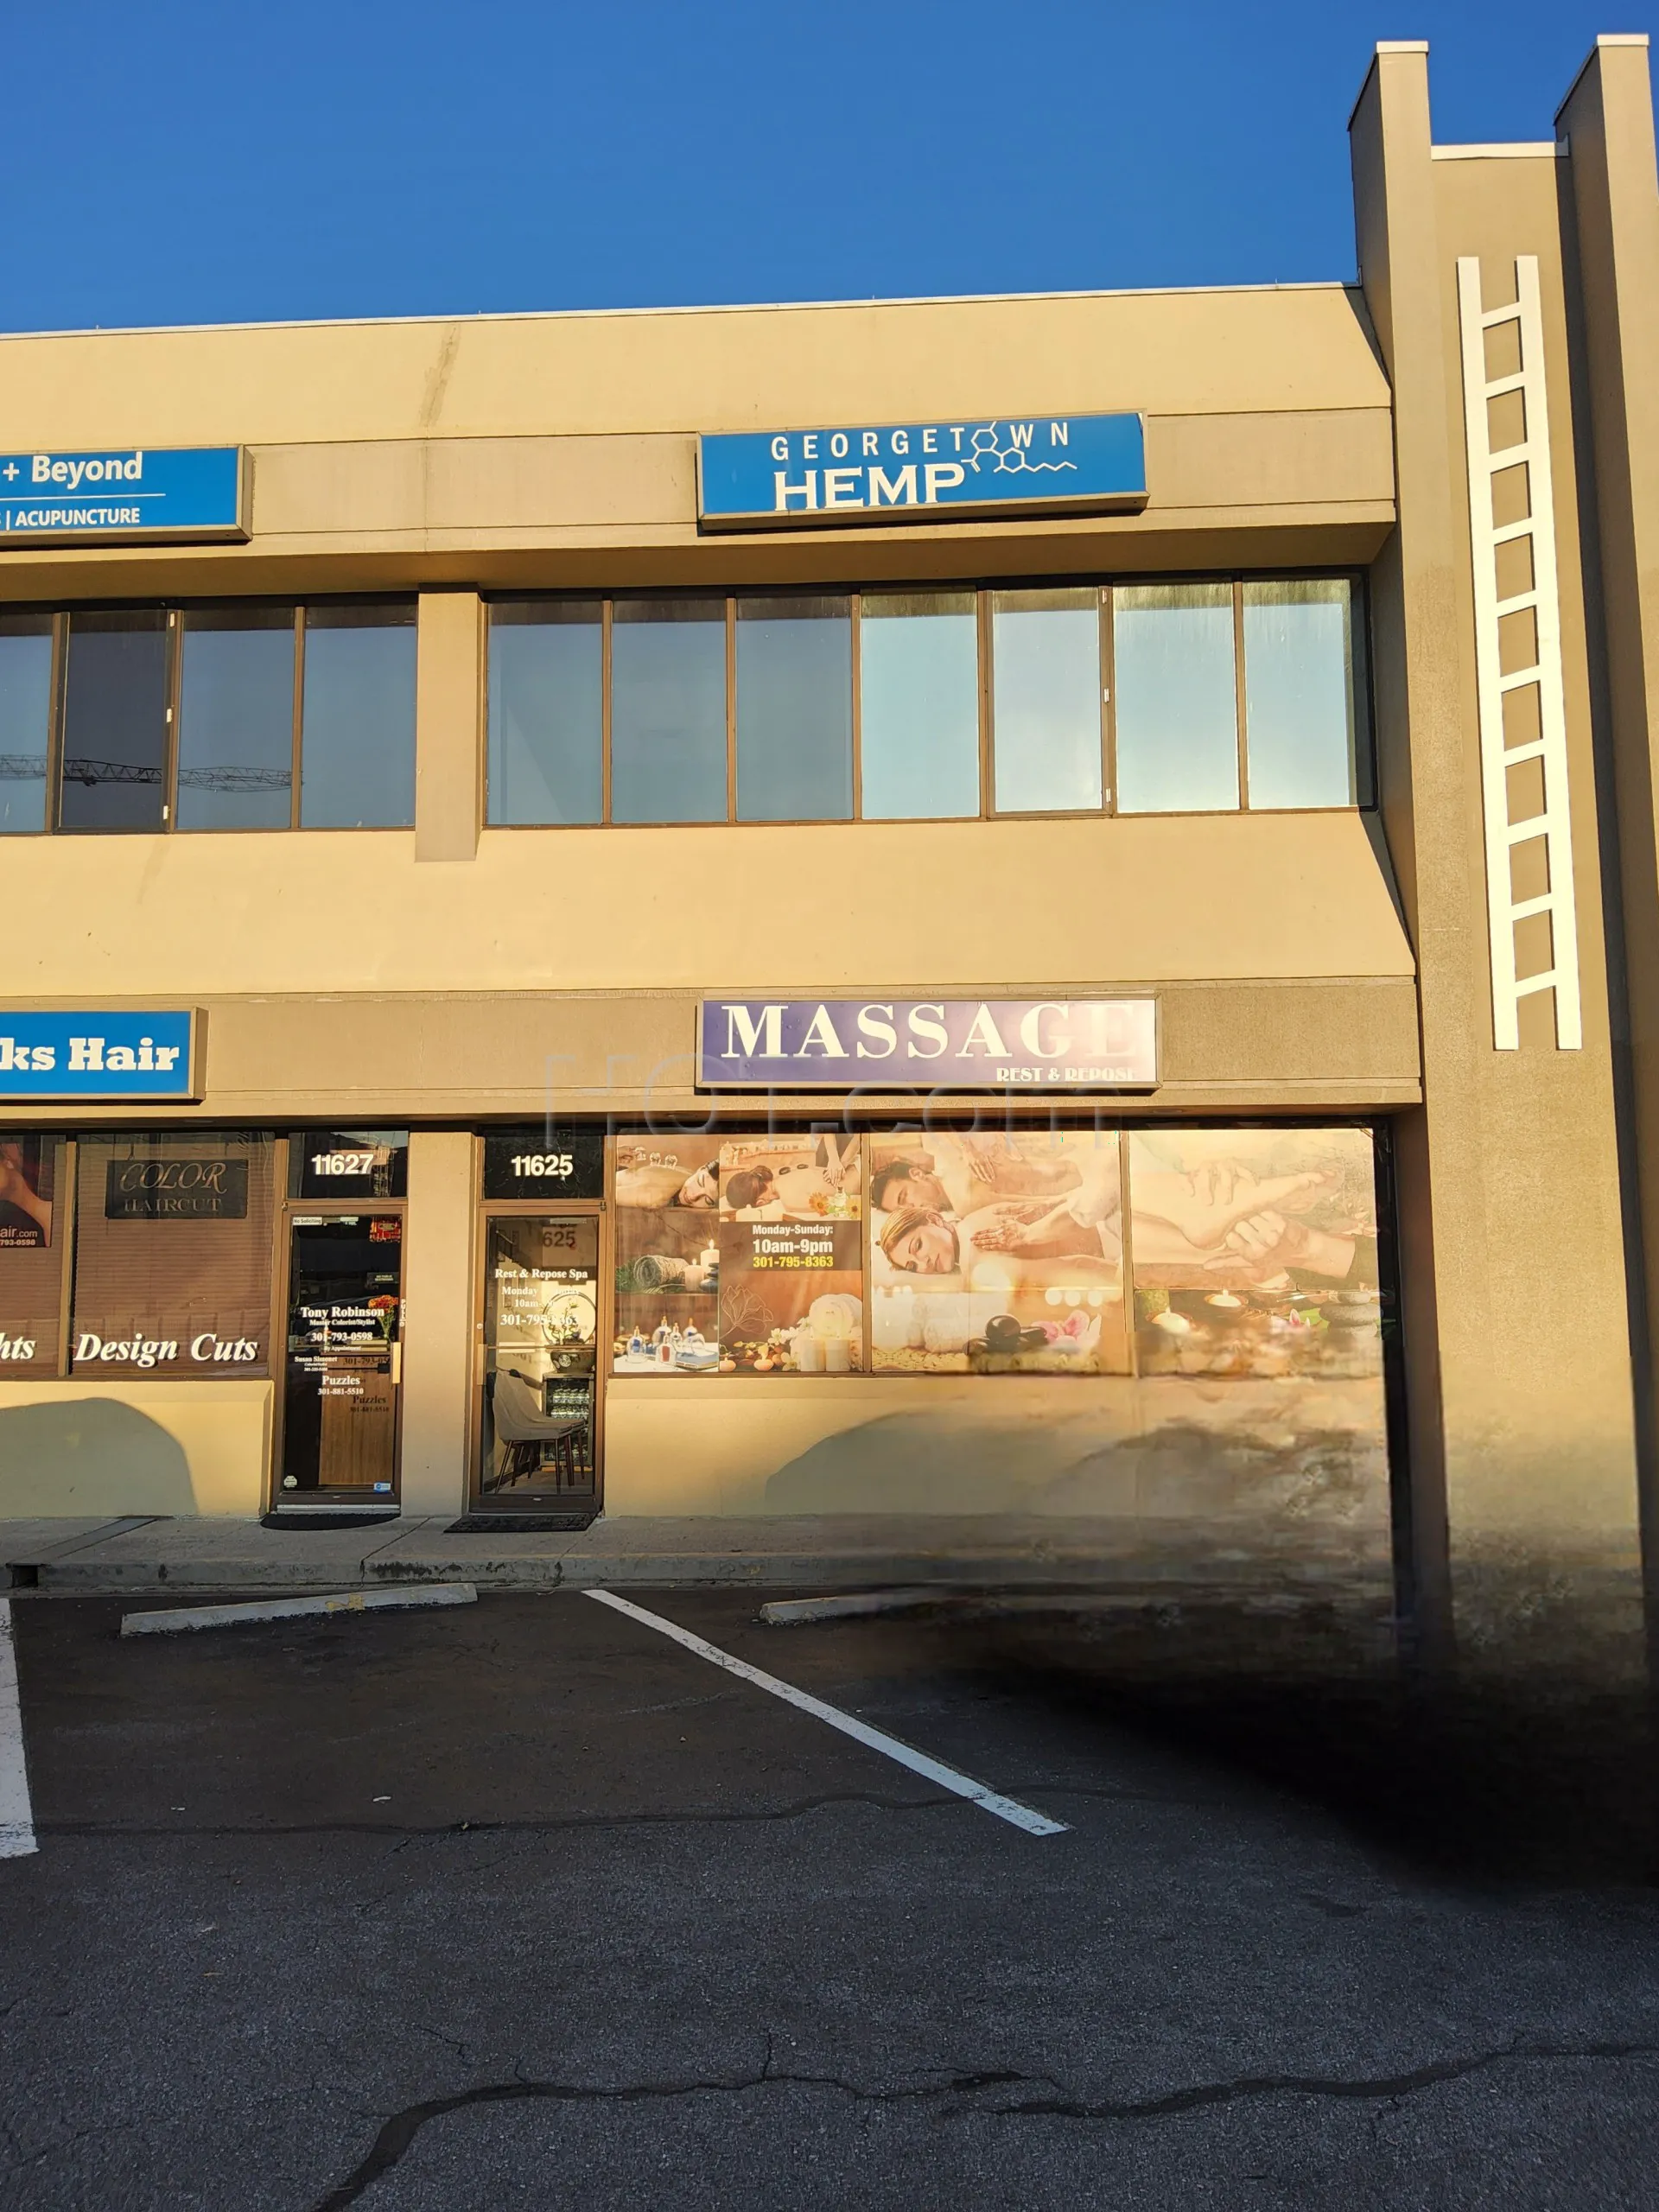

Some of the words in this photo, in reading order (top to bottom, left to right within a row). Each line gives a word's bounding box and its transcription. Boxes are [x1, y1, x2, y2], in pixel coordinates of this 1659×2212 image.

[32, 451, 143, 489] Beyond
[774, 463, 965, 511] HEMP
[15, 508, 140, 526] ACUPUNCTURE
[721, 1003, 1135, 1059] MASSAGE
[0, 1037, 55, 1071] ks
[68, 1037, 180, 1071] Hair
[996, 1067, 1043, 1082] REST
[1048, 1067, 1061, 1082] &
[1065, 1067, 1139, 1082] REPOSE
[311, 1154, 374, 1175] 11627
[511, 1154, 574, 1176] 11625
[119, 1162, 228, 1194] COLOR
[124, 1198, 223, 1212] HAIRCUT
[0, 1225, 38, 1237] air.com
[753, 1224, 834, 1236] Monday-Sunday:
[753, 1238, 833, 1256] 10am-9pm
[753, 1256, 834, 1268] 301-795-8363
[495, 1268, 518, 1278] Rest
[519, 1268, 529, 1278] &
[531, 1268, 567, 1281] Repose
[569, 1268, 588, 1281] Spa
[300, 1306, 328, 1319] Tony
[331, 1306, 385, 1318] Robinson
[311, 1332, 373, 1342] 301-793-0598
[73, 1333, 178, 1367] Design
[191, 1333, 258, 1362] Cuts
[321, 1375, 361, 1385] Puzzles
